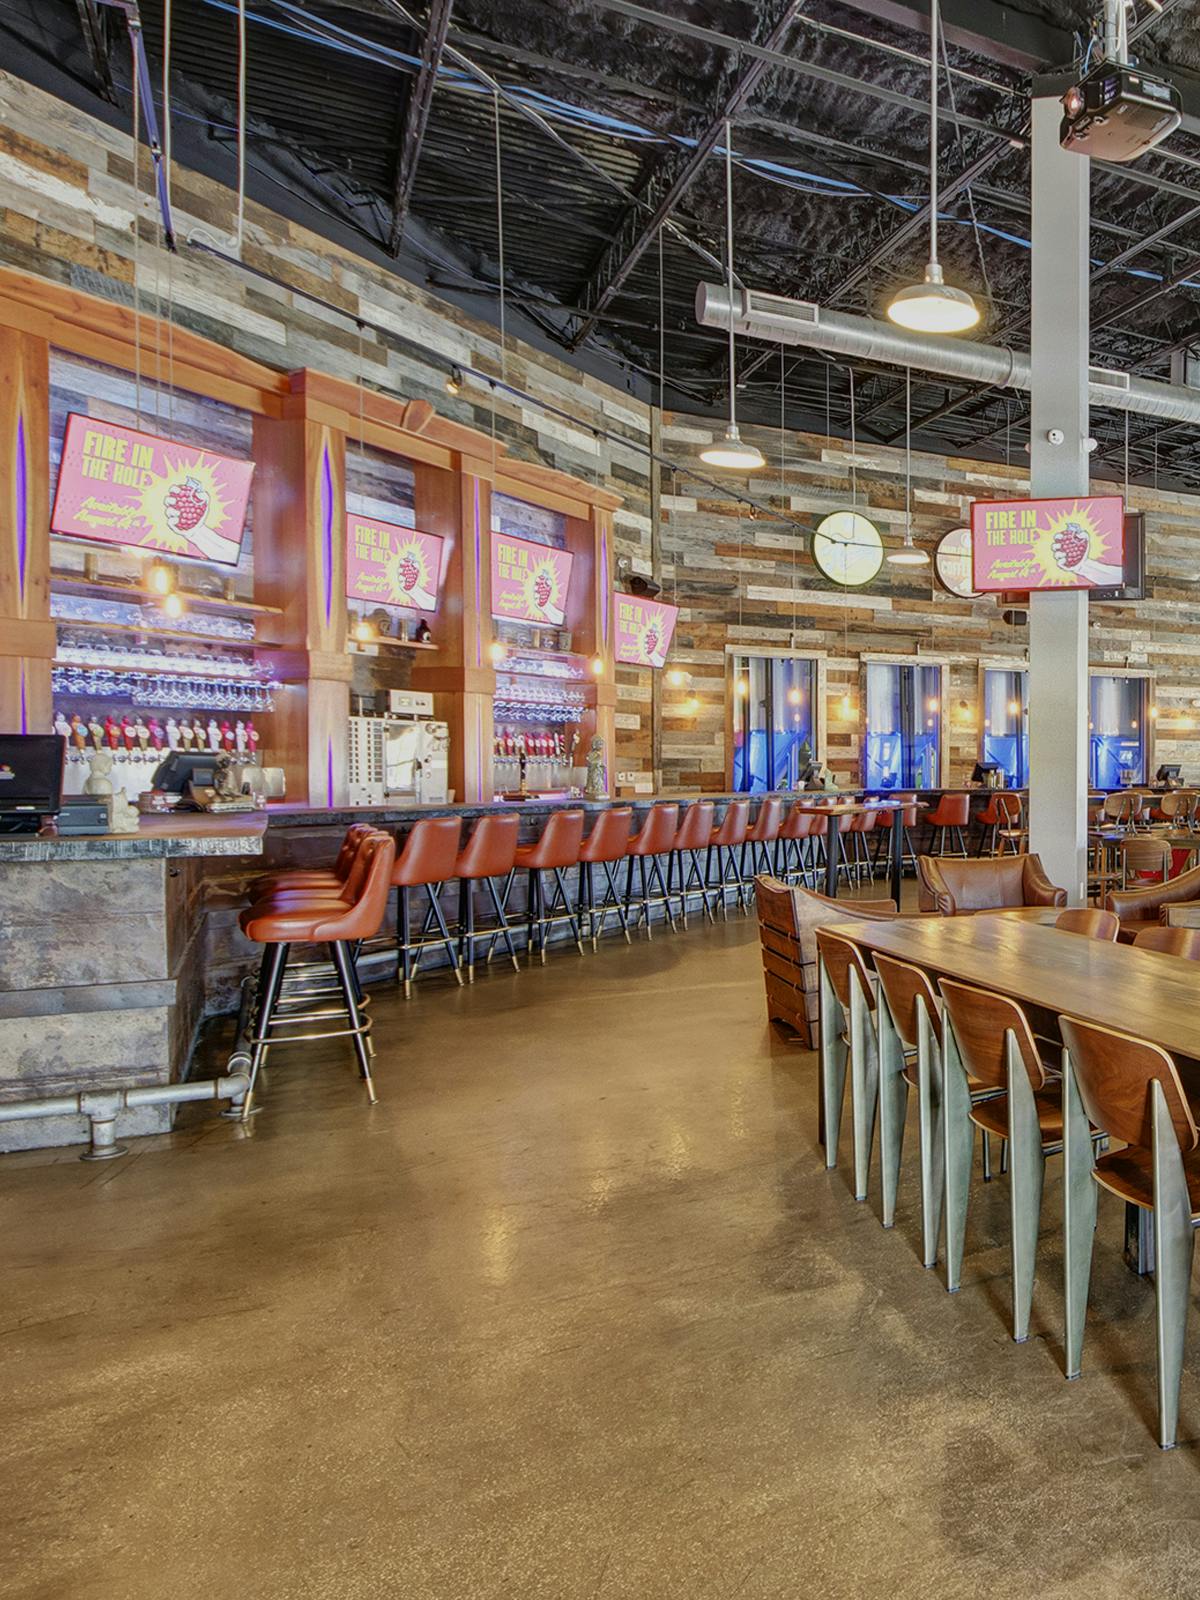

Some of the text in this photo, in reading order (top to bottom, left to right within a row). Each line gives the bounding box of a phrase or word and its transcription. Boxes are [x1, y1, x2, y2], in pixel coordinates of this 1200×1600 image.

[84, 431, 154, 470] FIRE IN
[82, 456, 109, 481] THE
[986, 510, 1036, 529] FIRE IN
[355, 525, 376, 545] FIRE
[987, 529, 1038, 546] THE HOLE
